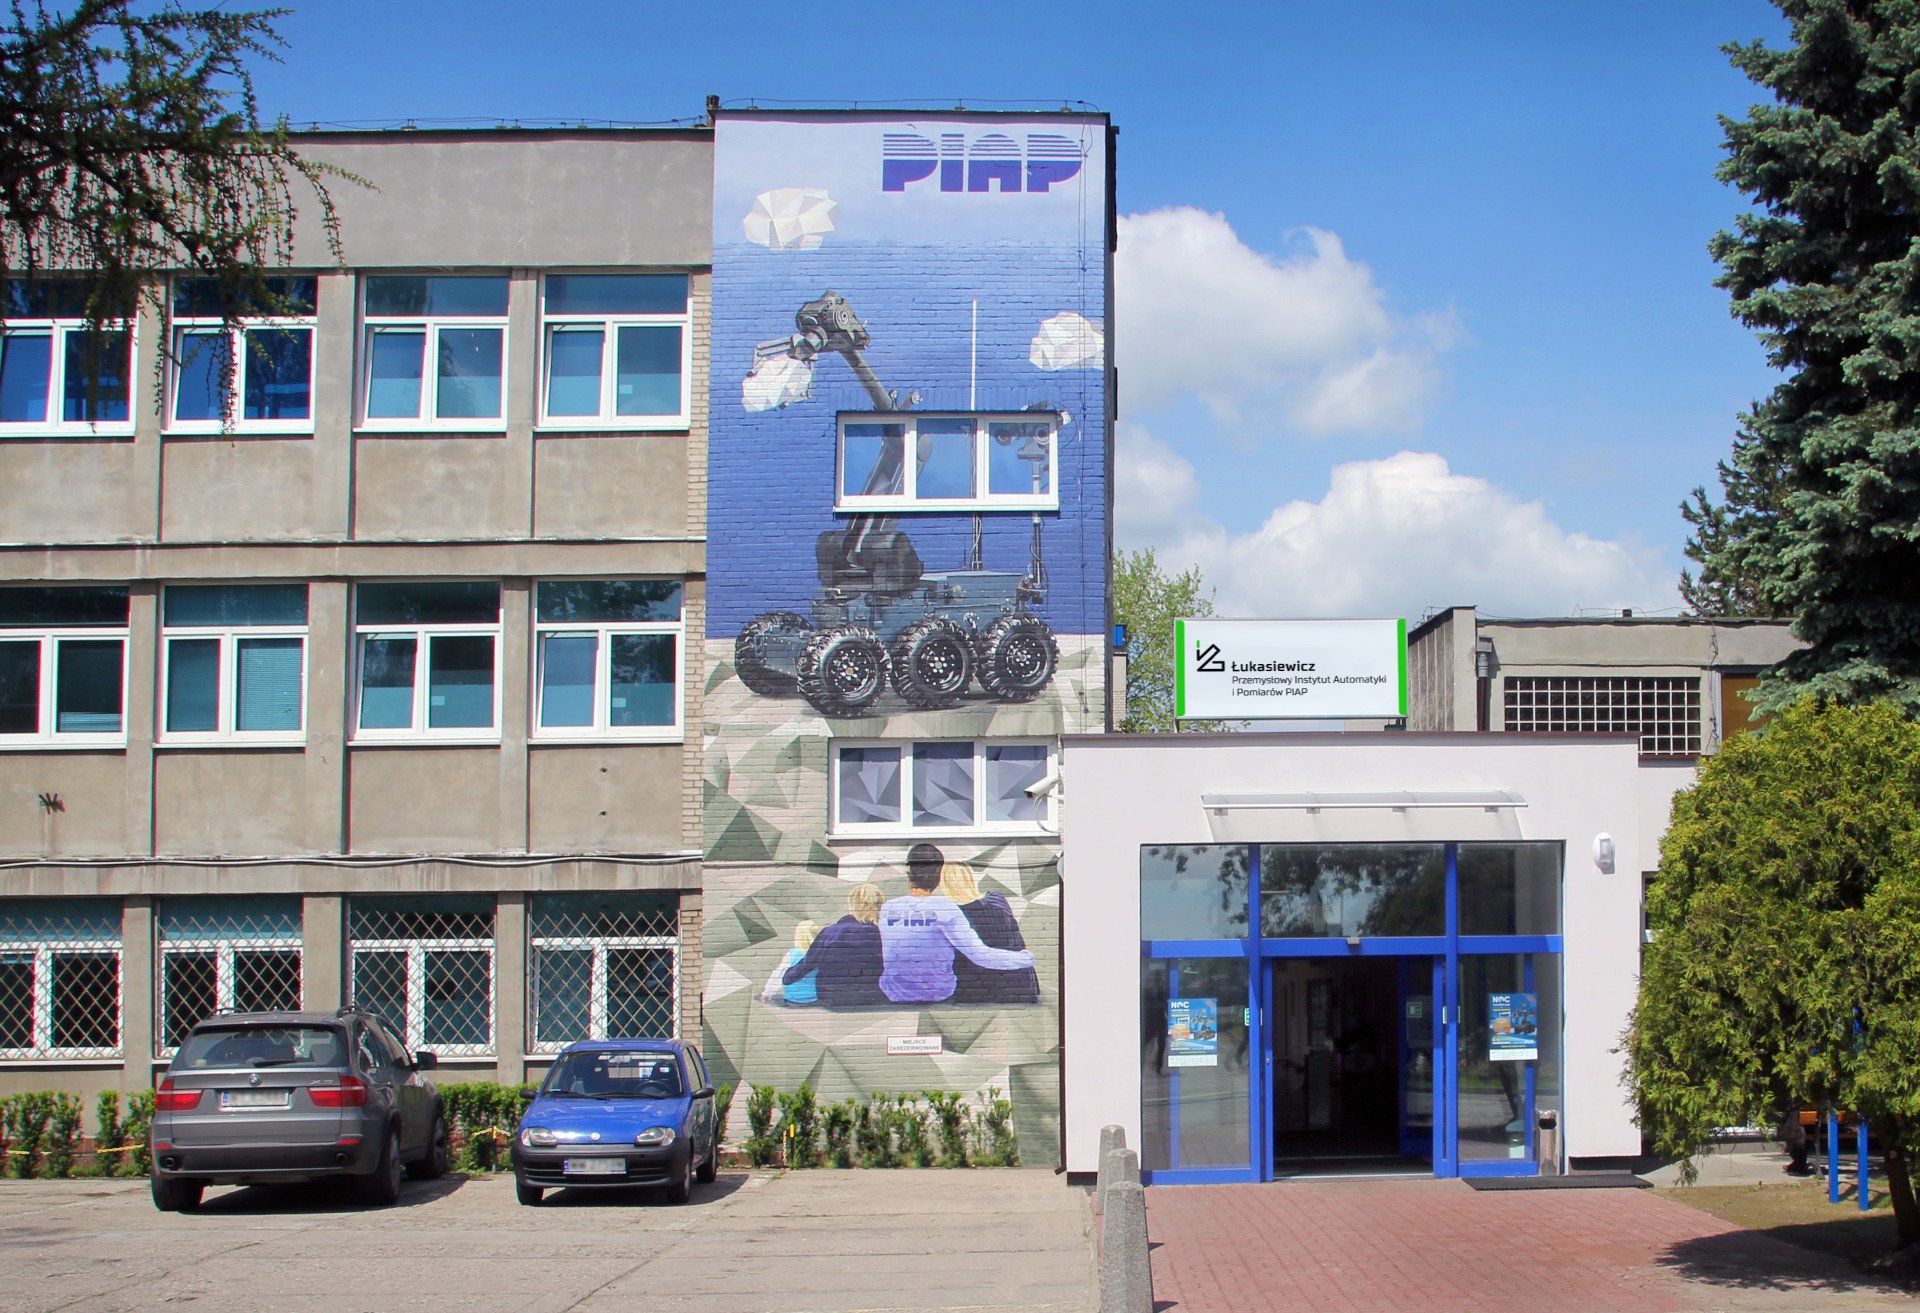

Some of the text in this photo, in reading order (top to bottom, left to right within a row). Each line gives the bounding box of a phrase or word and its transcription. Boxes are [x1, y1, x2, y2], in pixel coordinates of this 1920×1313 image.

[882, 133, 1082, 192] PIAP
[1231, 660, 1316, 672] Łukasiewicz
[1232, 674, 1387, 685] Przemysłowy Instytut Automatyki
[1236, 687, 1283, 696] Pomiarów
[1285, 687, 1308, 696] PIAP
[887, 910, 938, 926] PIAP
